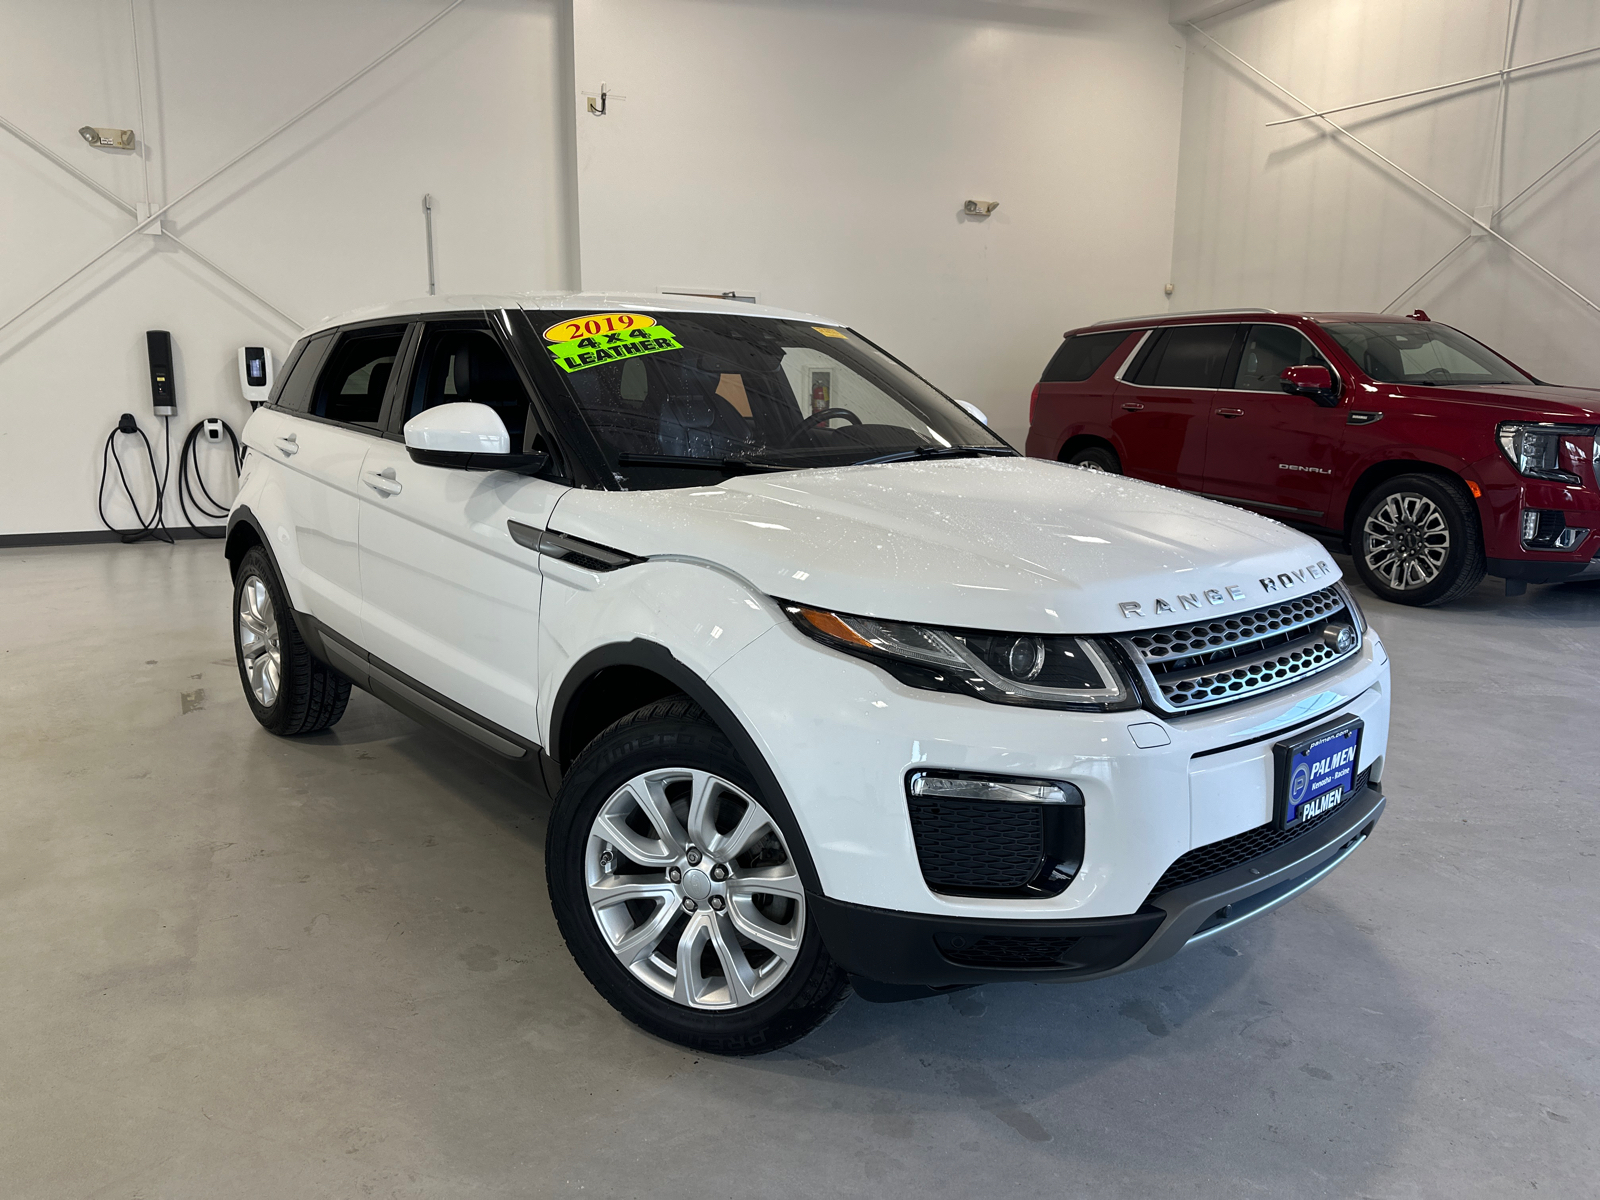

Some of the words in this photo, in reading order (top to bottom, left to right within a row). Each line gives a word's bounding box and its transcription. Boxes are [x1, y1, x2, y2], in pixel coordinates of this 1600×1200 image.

[565, 315, 634, 340] 2019
[564, 337, 676, 370] LEATHER
[1278, 463, 1332, 474] DENALI
[1118, 584, 1246, 618] RANGE
[1258, 560, 1332, 593] ROVER
[1309, 729, 1349, 749] palmen.com
[1310, 744, 1357, 780] PALMEN
[1311, 776, 1332, 791] Kenosha
[1334, 767, 1350, 780] Racine
[1302, 787, 1342, 822] PALMEN
